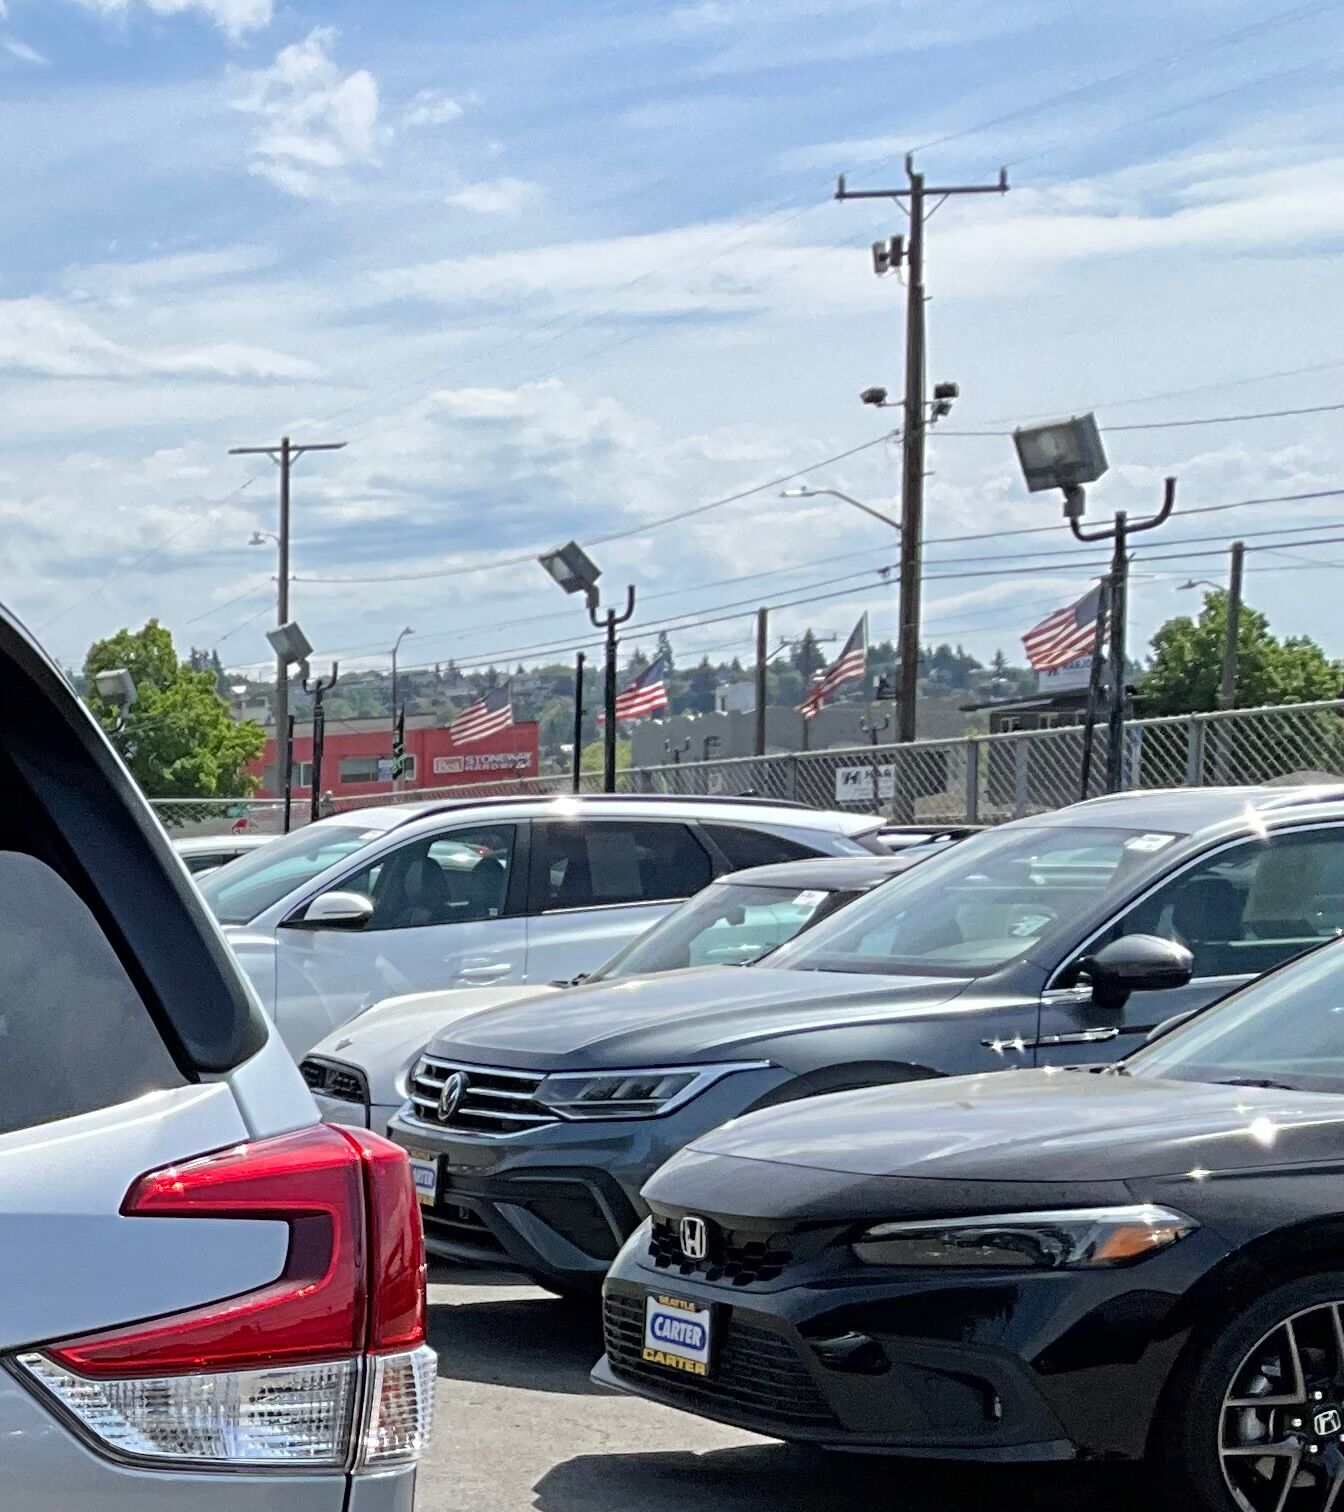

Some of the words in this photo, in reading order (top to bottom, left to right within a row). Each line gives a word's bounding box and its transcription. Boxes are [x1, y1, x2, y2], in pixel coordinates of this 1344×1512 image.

[464, 761, 531, 772] HARDW
[654, 1315, 702, 1347] CARTER
[642, 1347, 707, 1376] CARTER
